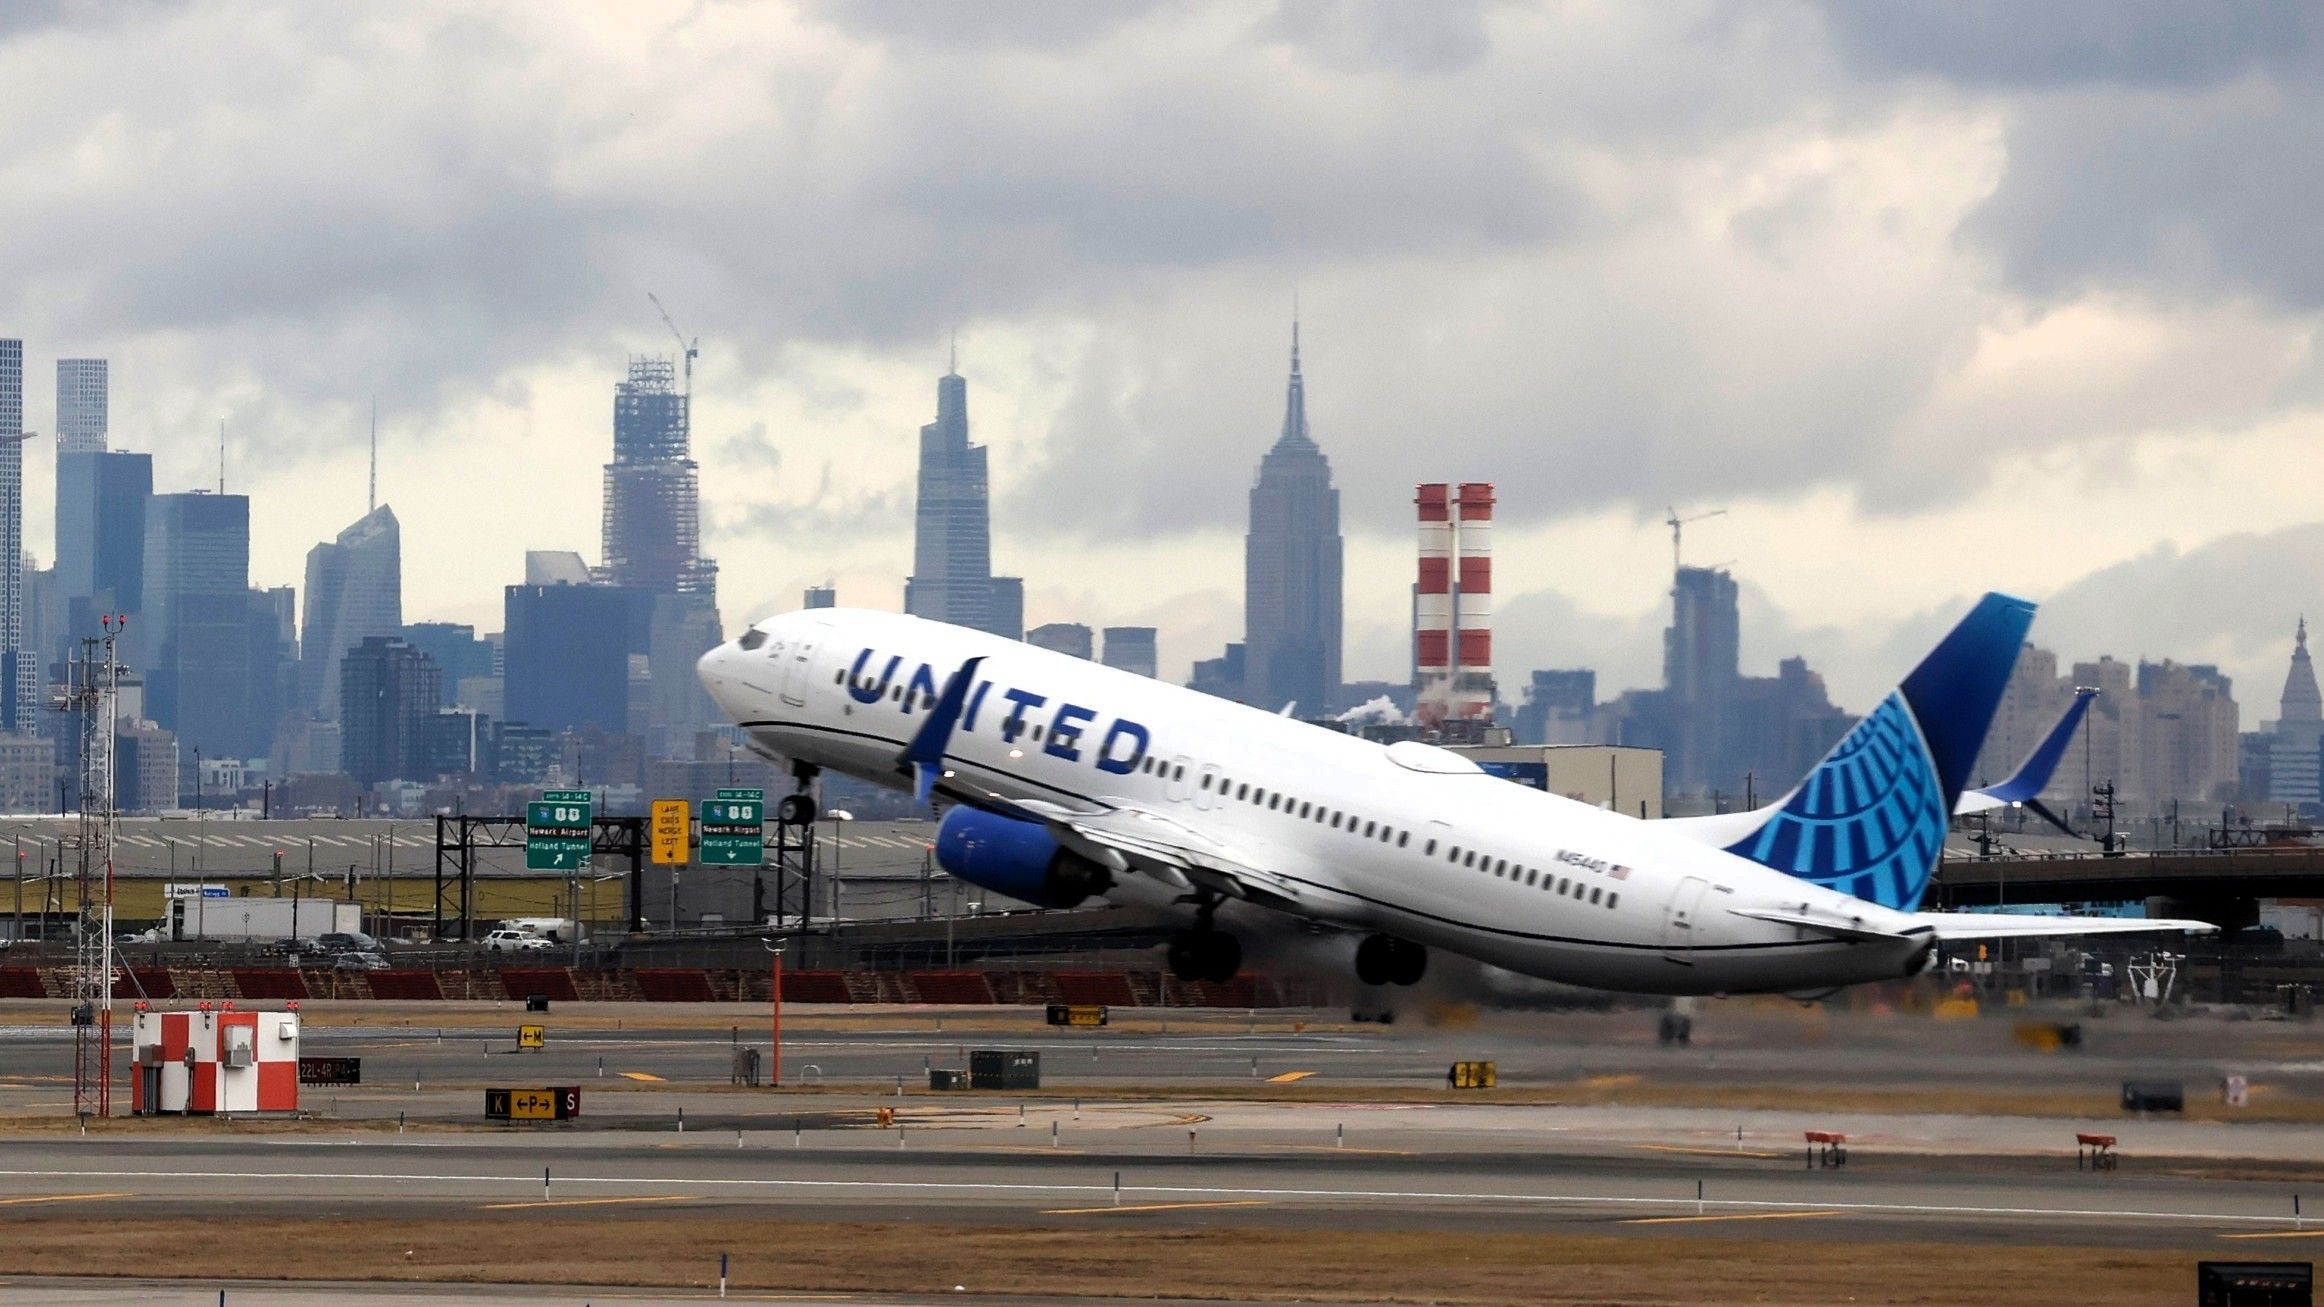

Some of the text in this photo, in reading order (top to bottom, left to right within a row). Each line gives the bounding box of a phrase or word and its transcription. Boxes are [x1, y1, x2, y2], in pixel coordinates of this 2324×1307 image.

[847, 648, 1150, 775] UNITED
[529, 827, 588, 837] Newark Airport
[703, 825, 760, 835] Newark Airport
[529, 842, 588, 851] Holland Tunnel
[703, 839, 760, 848] Holland Tunnel
[533, 1030, 542, 1043] M
[495, 1095, 537, 1113] K P
[566, 1093, 575, 1110] S
